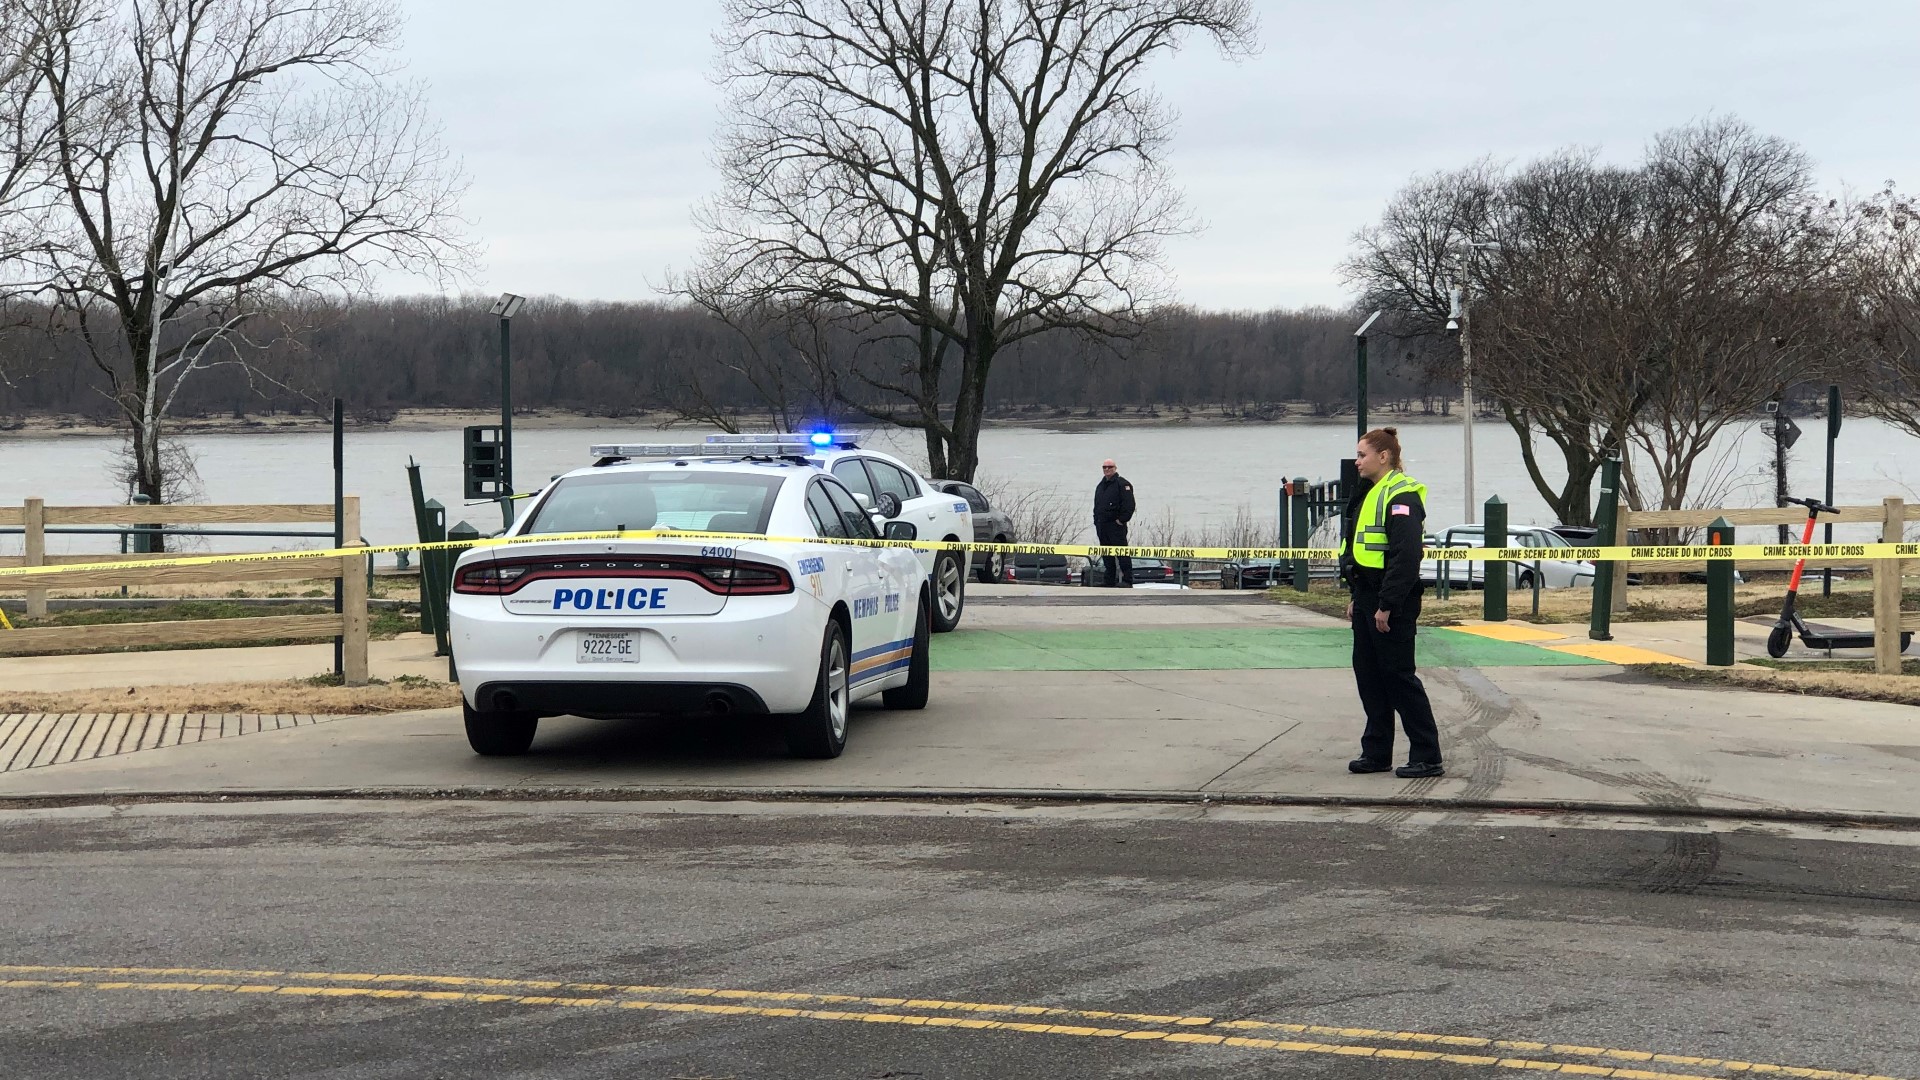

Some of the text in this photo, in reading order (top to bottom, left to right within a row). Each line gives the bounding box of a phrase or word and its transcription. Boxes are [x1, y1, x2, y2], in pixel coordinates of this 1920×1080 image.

[701, 546, 733, 558] 6400
[946, 543, 1055, 554] CRIME SCENE DO NOT CROSS
[1088, 547, 1195, 558] CRIME SCENE DO NOT CROSS
[1498, 549, 1600, 559] CRIME SCENE DO NOT CROSS
[1631, 547, 1733, 558] CRIME SCENE DO NOT CROSS
[1763, 546, 1864, 556] CRIME SCENE DO NOT CROSS
[1895, 544, 1918, 554] CRIME
[1227, 550, 1332, 559] CRIME SCENE DO NOT CROSS
[1427, 550, 1442, 559] NOT
[1444, 550, 1467, 559] CROSS
[810, 575, 824, 597] 911
[553, 587, 669, 610] POLICE
[853, 593, 899, 619] MEMPHIS POLICE
[583, 640, 632, 654] 9222-GE
